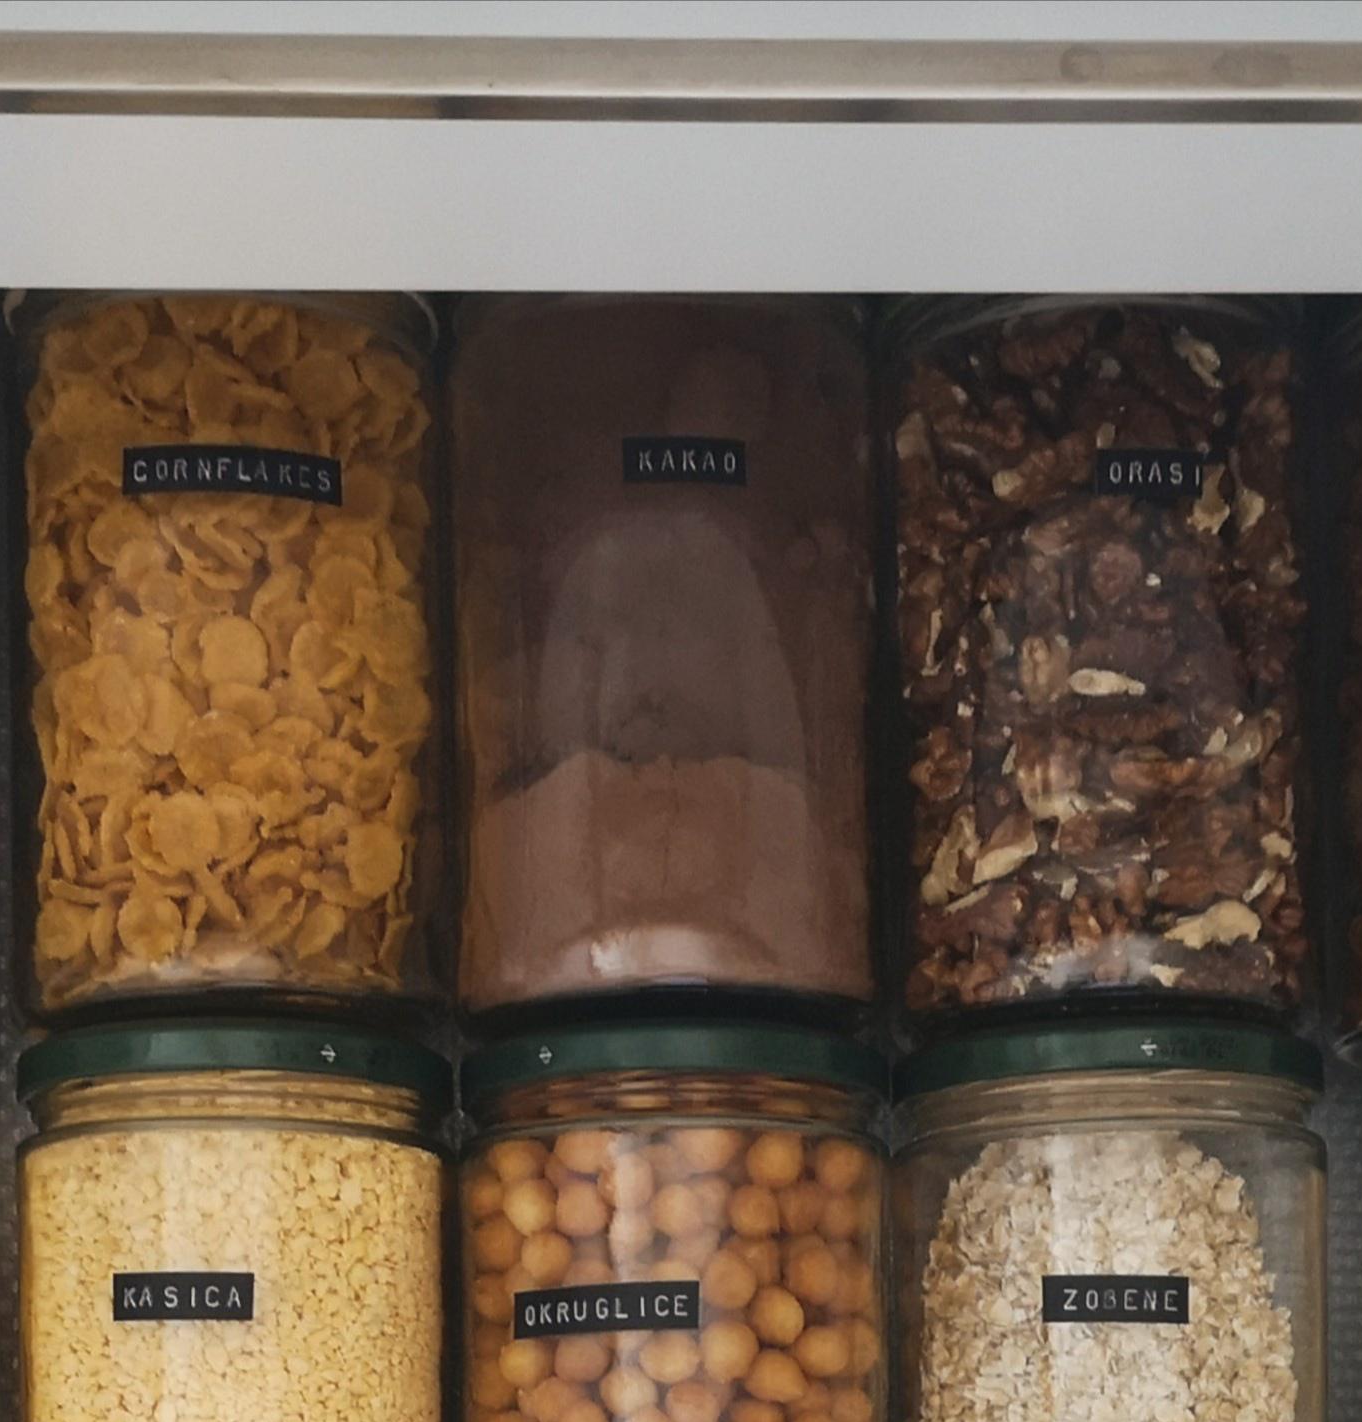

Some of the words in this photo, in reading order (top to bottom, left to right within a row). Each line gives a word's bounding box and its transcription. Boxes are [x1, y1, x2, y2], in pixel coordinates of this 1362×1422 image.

[638, 450, 738, 474] KAKAO
[1108, 461, 1201, 487] ORASI
[132, 457, 333, 493] CORNFLAKES
[123, 1285, 243, 1310] KASICA
[524, 1293, 690, 1325] OKRUGLICE
[1063, 1288, 1179, 1313] ZOBENE
